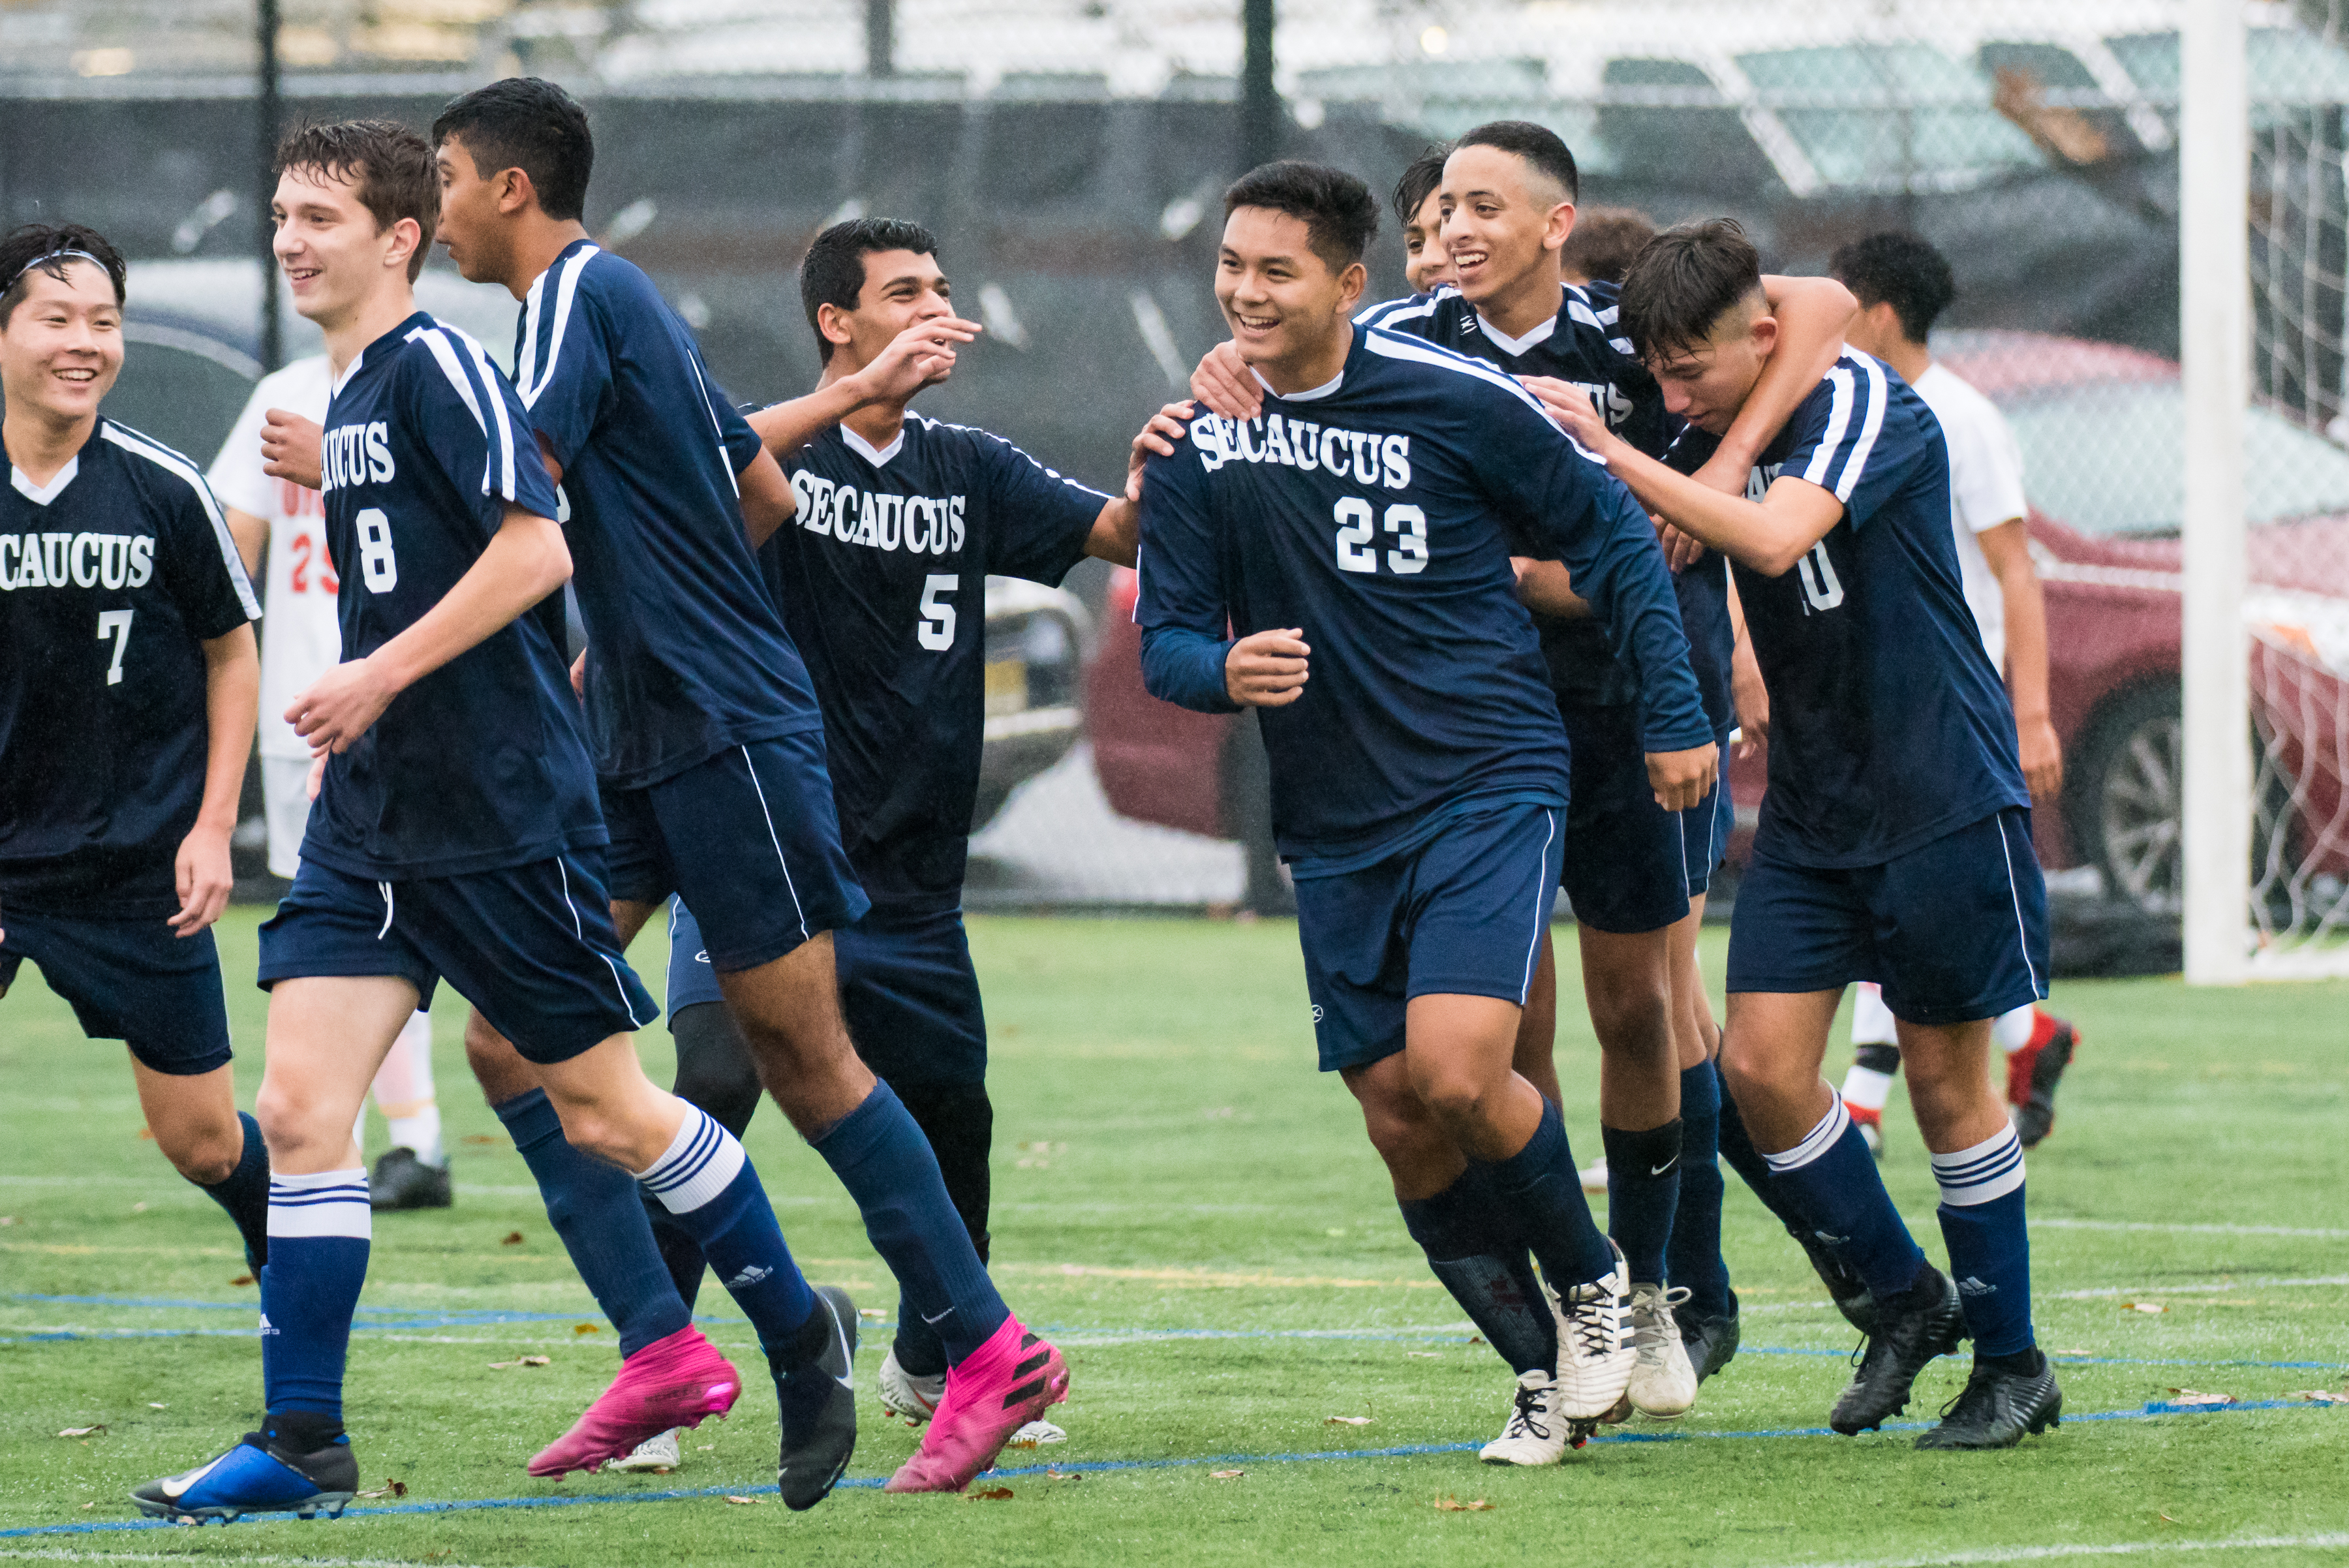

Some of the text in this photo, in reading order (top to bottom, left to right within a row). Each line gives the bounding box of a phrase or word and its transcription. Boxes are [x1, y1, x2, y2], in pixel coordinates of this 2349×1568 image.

[1190, 412, 1411, 489] SECAUCUS
[791, 469, 966, 555] SECAUCUS
[1334, 496, 1429, 574] 23
[0, 532, 155, 591] CAUCUS
[356, 508, 397, 594] 8
[98, 609, 134, 686] 7
[917, 574, 959, 651] 5
